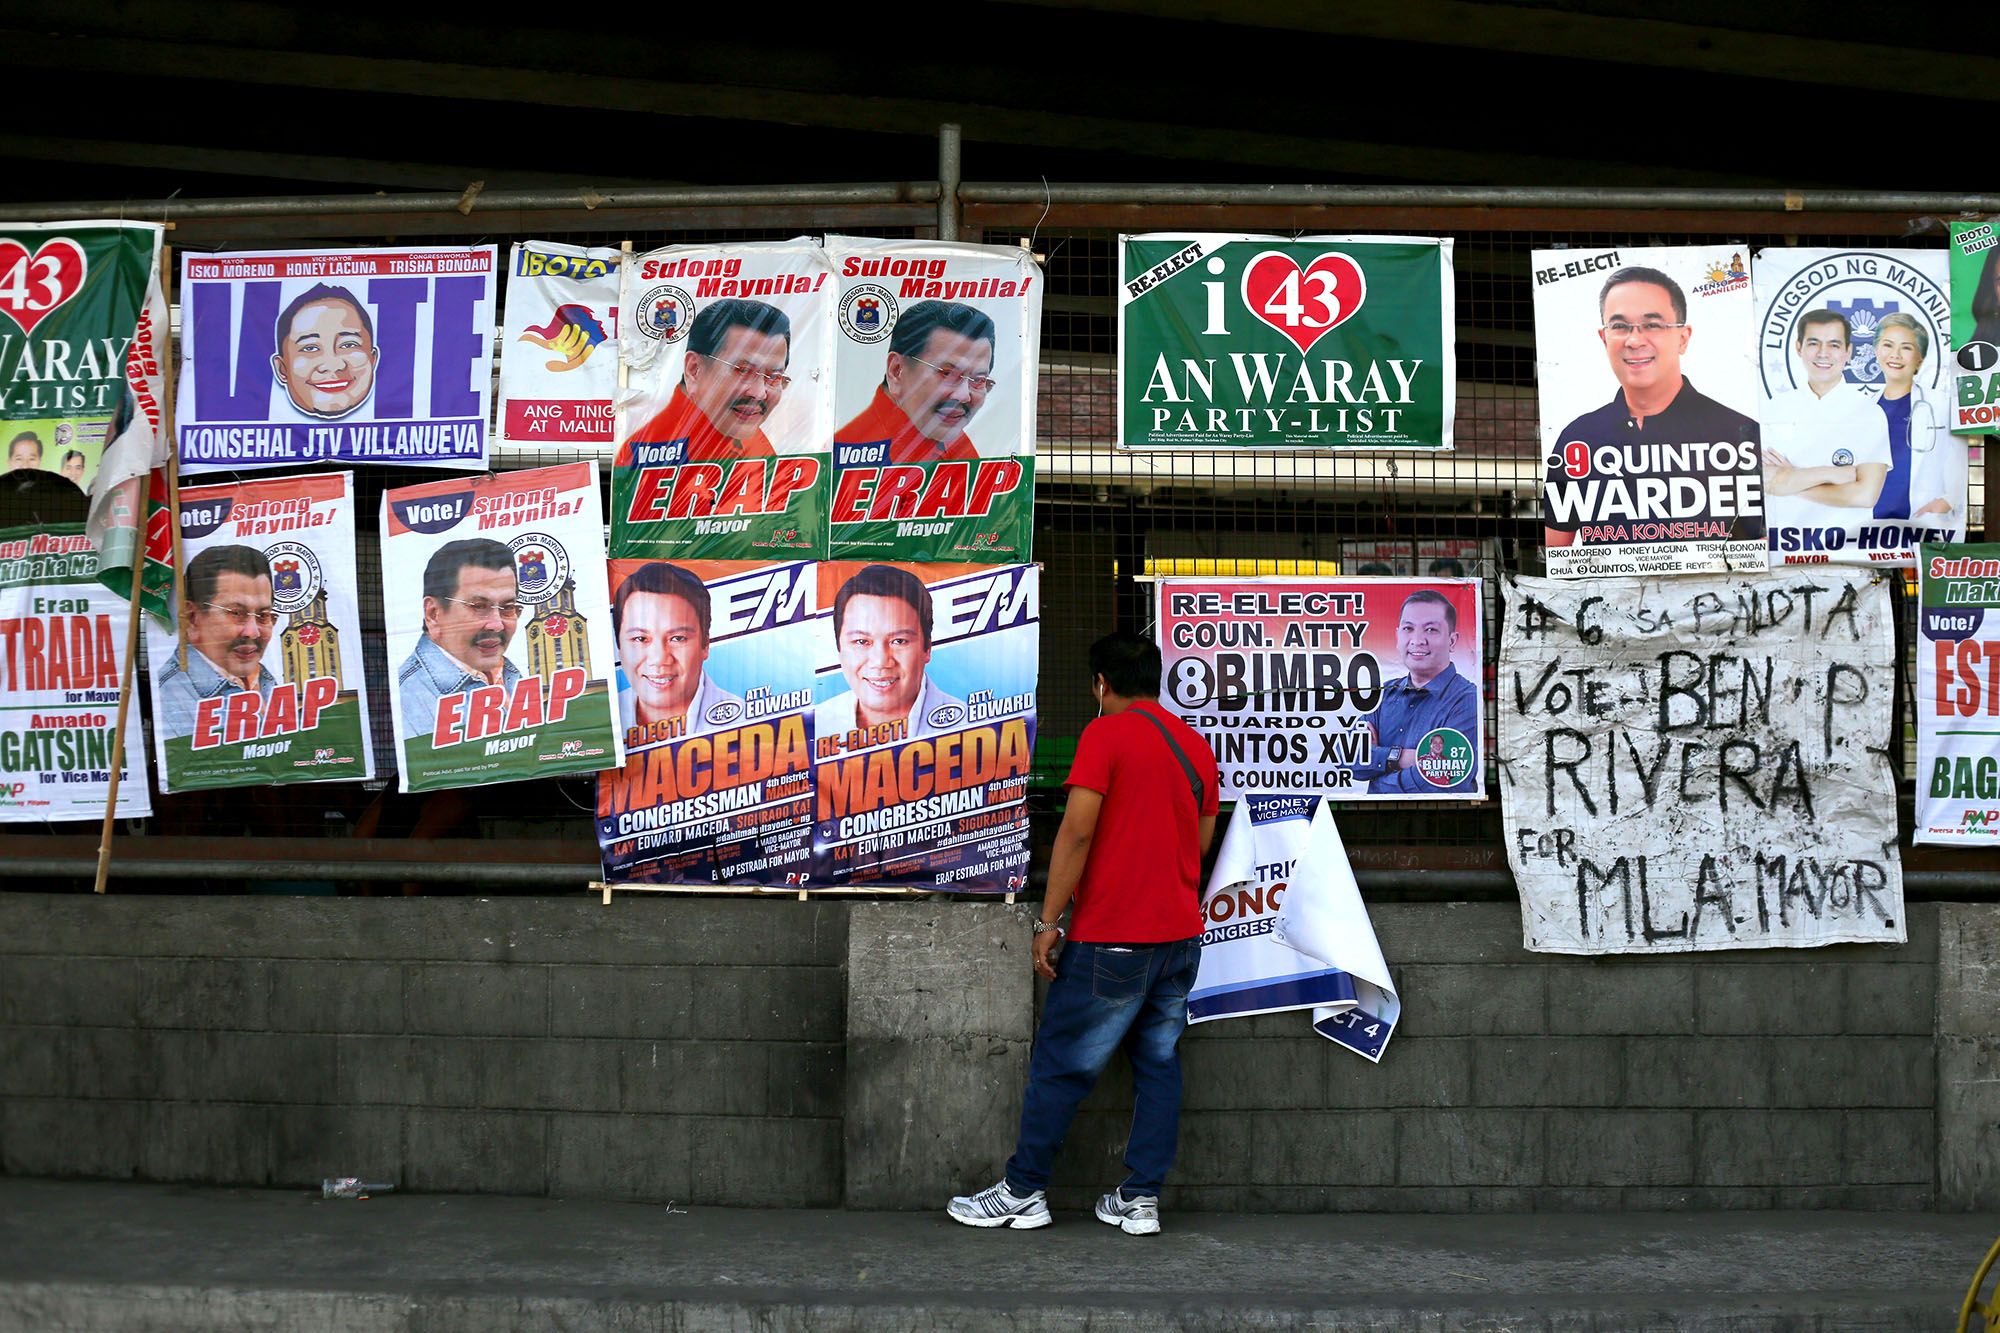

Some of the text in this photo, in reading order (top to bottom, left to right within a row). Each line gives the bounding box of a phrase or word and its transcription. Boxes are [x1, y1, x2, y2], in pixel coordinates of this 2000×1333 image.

[1955, 225, 1993, 245] IBOTO
[1963, 236, 1998, 255] MULI!
[190, 264, 275, 277] ISKO MORENO
[286, 261, 377, 275] HONEY LACUNA
[389, 258, 489, 273] TRISHA BONOAN
[521, 251, 607, 278] IBOTO
[641, 258, 742, 280] Sulong
[842, 256, 947, 278] Sulong
[1126, 243, 1204, 298] RE-ELECT
[1536, 251, 1622, 286] RE-ELECT!
[0, 256, 62, 310] 43
[696, 273, 827, 298] Maynila!
[899, 277, 1033, 299] Maynila!
[1692, 280, 1728, 293] ASENSO
[1201, 256, 1341, 335] i 43
[1766, 259, 1951, 350] LUNGSOD NG MAYNILA
[0, 334, 132, 383] ARAY
[1968, 344, 1982, 369] 1
[1140, 351, 1423, 404] AN WARAY
[524, 404, 563, 418] ANG
[1151, 407, 1403, 433] PARTY-LIST
[528, 420, 548, 432] AT
[185, 423, 479, 458] KONSEHAL JTV VILLANUEVA
[638, 442, 682, 464] Vote!
[839, 444, 885, 465] Vote!
[1565, 441, 1758, 478] 9 QUINTOS
[626, 457, 821, 524] ERAP
[831, 459, 1023, 524] ERAP
[1545, 475, 1763, 523] WARDEE
[180, 496, 312, 527] ote! Sulong
[407, 486, 557, 525] Vote! Sulong
[478, 497, 584, 530] Maynila!
[235, 508, 337, 538] Maynila!
[695, 517, 752, 535] Mayor
[896, 521, 954, 537] Mayor
[1582, 525, 1629, 542] PARA
[1619, 545, 1688, 555] HONEY LACUNA
[1696, 543, 1766, 552] TRISHA BONOAN
[1768, 526, 1956, 552] ISKO-HONEY
[1548, 548, 1611, 558] ISKO MORENO
[1785, 555, 1829, 564] MAYOR
[70, 555, 99, 576] Na
[1550, 562, 1682, 575] CHUA QUINTOS, WARDEE
[34, 597, 90, 615] Erap
[1172, 594, 1364, 615] RE-ELECT!
[1929, 615, 1975, 630] Vote!
[1173, 622, 1368, 648] COUN. ATTY
[0, 614, 119, 692] TRADA
[1175, 652, 1383, 712] 8 BIMBO
[1656, 650, 1774, 734] BEN
[65, 690, 120, 703] for Mayor
[746, 686, 772, 702] ATTY.
[746, 688, 812, 719] EDWARD
[968, 689, 994, 705] ATTY.
[191, 675, 338, 751] ERAP
[432, 667, 587, 750] ERAP
[968, 692, 1034, 722] EDWARD
[30, 713, 107, 729] Amado
[1181, 716, 1326, 729] EDUARDO
[243, 739, 292, 760] Mayor
[484, 733, 537, 756] Mayor
[817, 718, 908, 759] RE-ELECT!
[1203, 733, 1369, 764] INTOS XVI
[1450, 747, 1466, 758] 87
[598, 715, 810, 818] MACEDA
[817, 718, 1030, 822] MACEDA
[1422, 760, 1468, 770] BUHAY
[1545, 728, 1816, 823] RIVERA
[40, 771, 88, 784] for Vice
[766, 771, 810, 788] 4th District
[988, 782, 1001, 792] 4th
[1232, 770, 1353, 788] COUNCILOR
[1930, 756, 2000, 800] BAG
[766, 783, 810, 801] MANILA
[618, 783, 762, 834] CONGRESSMAN
[839, 787, 983, 839] CONGRESSMAN
[1257, 807, 1309, 821] VICE MAYOR
[614, 841, 634, 856] KAY
[637, 831, 682, 850] EDWARD
[793, 798, 811, 815] KA!
[834, 845, 856, 861] KAY
[858, 834, 904, 856] EDWARD
[959, 809, 1011, 833] SIGURADO
[764, 840, 801, 854] VICE-MAYOR
[977, 840, 999, 852] AMADO
[986, 843, 1023, 858] VICE-MAYOR
[1517, 828, 1578, 867] FOR
[737, 848, 810, 876] ESTRADA FOR MAYOR
[936, 870, 953, 885] ERAP
[956, 864, 989, 881] ESTRADA
[990, 859, 1004, 872] FOR
[1006, 851, 1030, 867] MAYOR
[1364, 1023, 1379, 1038] 4
